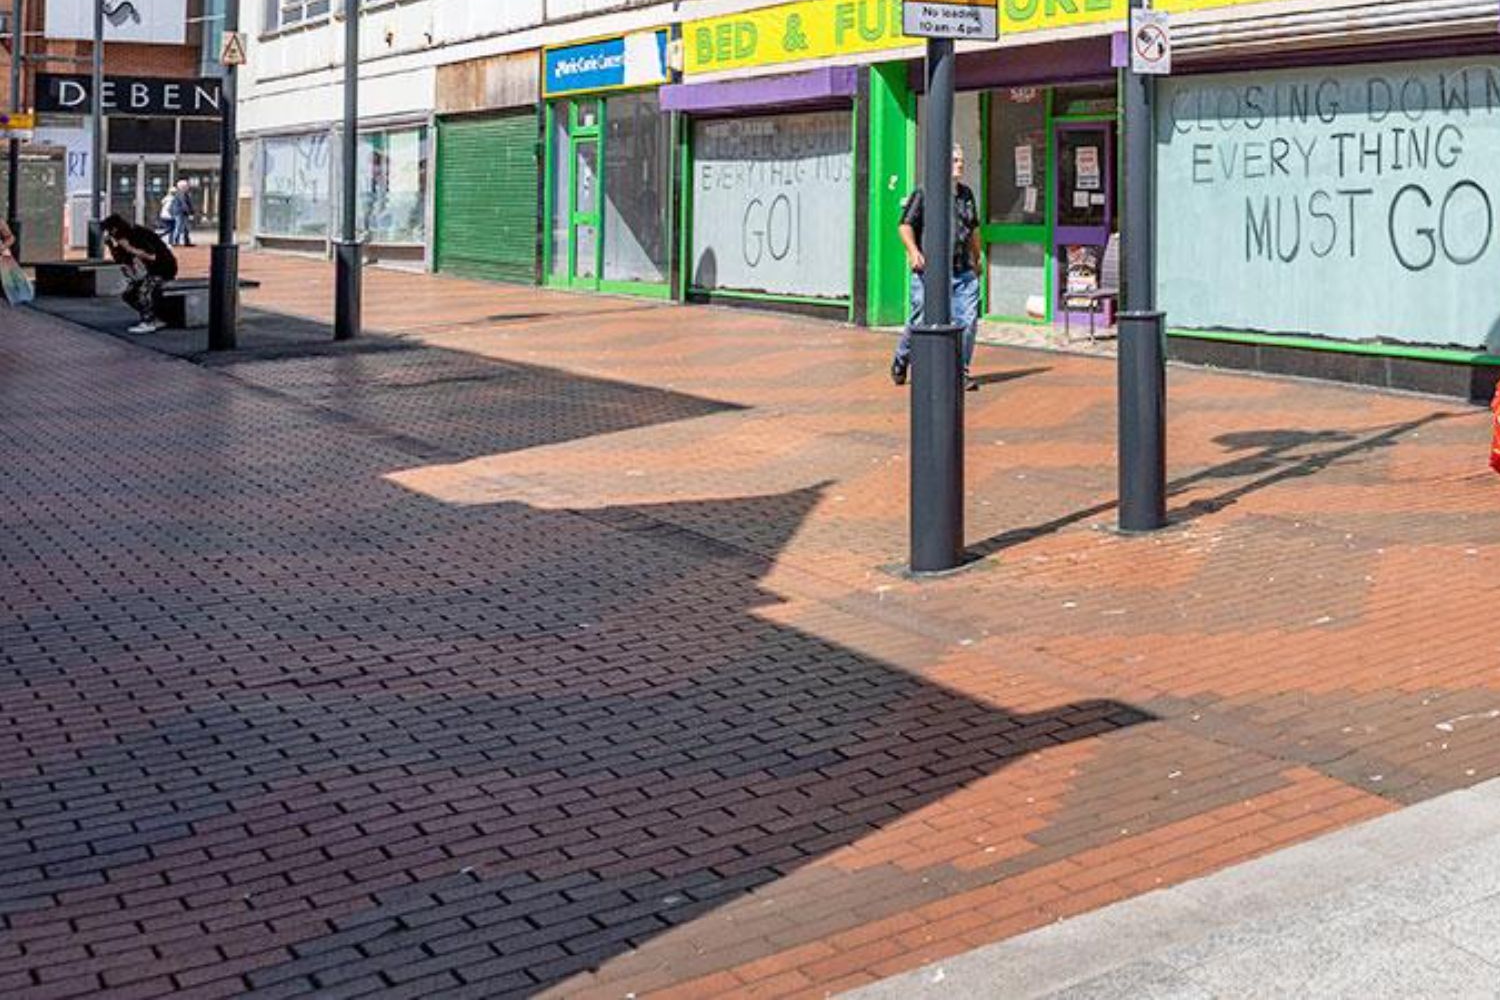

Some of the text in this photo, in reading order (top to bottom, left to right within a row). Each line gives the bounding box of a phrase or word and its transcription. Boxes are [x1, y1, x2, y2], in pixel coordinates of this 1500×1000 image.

[696, 20, 758, 66] BED
[782, 12, 809, 53] &
[921, 6, 981, 22] No loading
[1169, 78, 1341, 134] CLOSING
[1245, 188, 1373, 263] MUST
